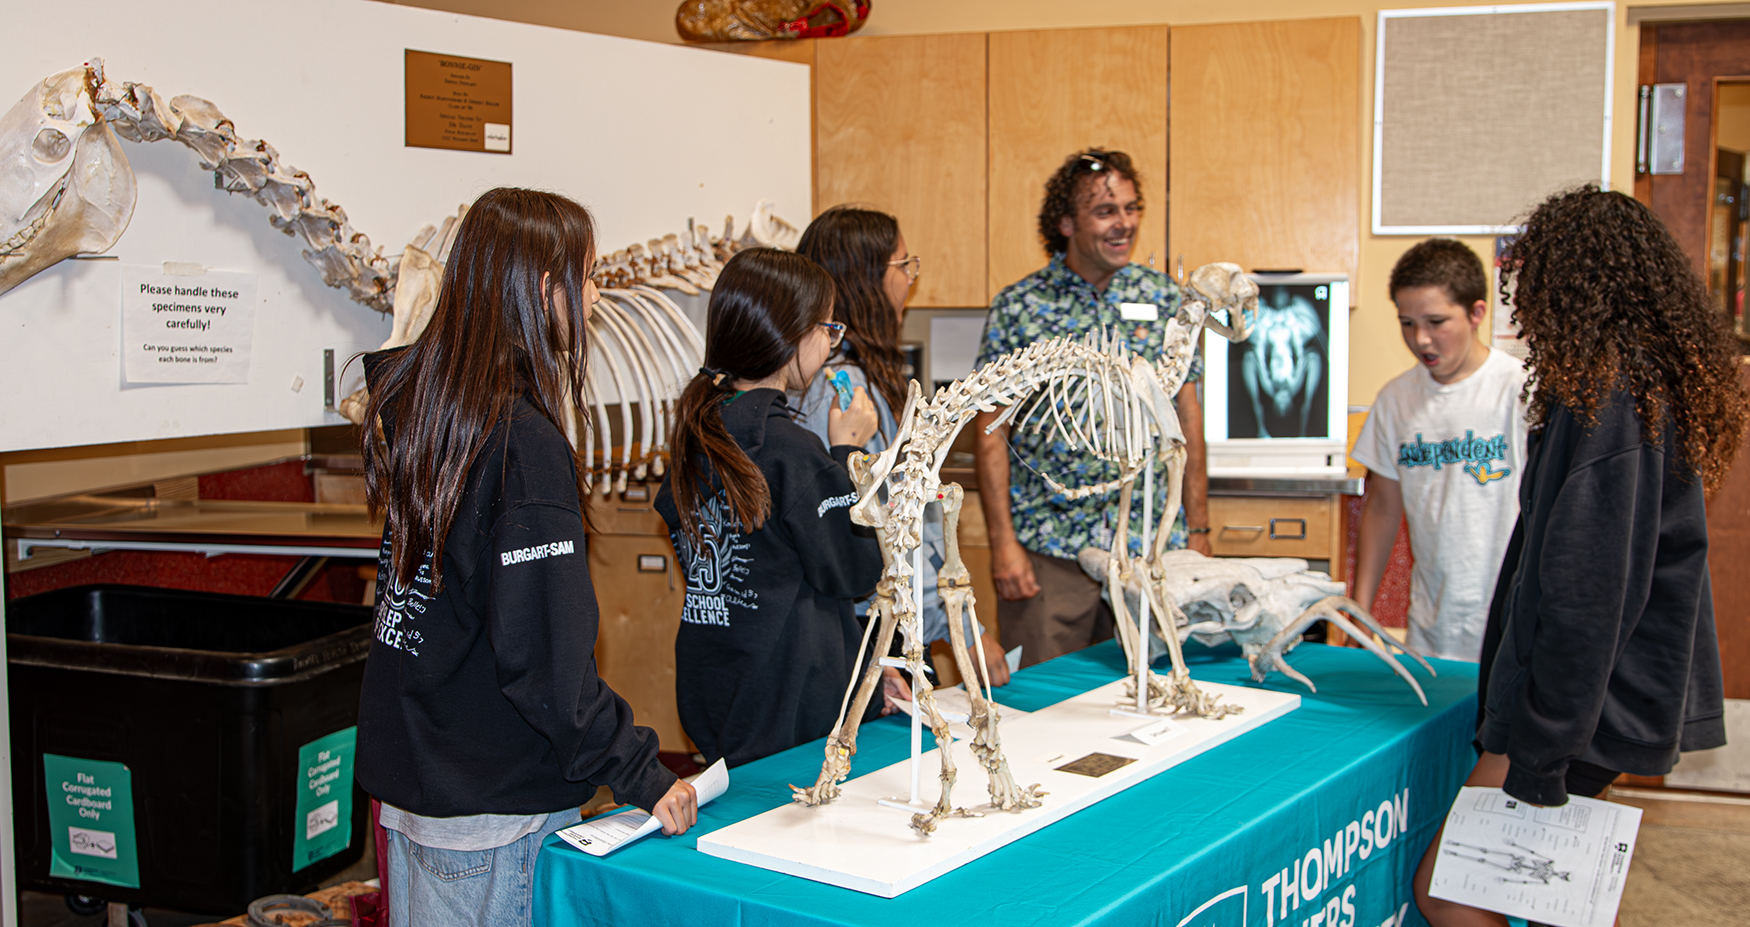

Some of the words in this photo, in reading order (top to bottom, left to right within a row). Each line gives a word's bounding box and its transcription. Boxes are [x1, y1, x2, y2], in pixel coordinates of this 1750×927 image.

[140, 283, 172, 295] Please
[174, 285, 208, 297] handle
[211, 287, 239, 299] these
[152, 302, 202, 313] specimens
[204, 305, 227, 316] very
[166, 319, 211, 331] carefully!
[157, 345, 169, 353] you
[189, 344, 208, 352] which
[209, 345, 233, 354] species
[158, 355, 174, 363] each
[175, 355, 191, 363] bone
[192, 355, 198, 363] is
[501, 540, 575, 567] BURGART-SAM
[686, 592, 729, 611] SCHOOL
[681, 606, 731, 627] ELLENCE
[77, 772, 95, 785] Flat
[62, 781, 111, 797] Corrugated
[66, 794, 112, 810] Cardboard
[78, 807, 100, 821] Only
[1262, 788, 1409, 927] THOMPSON
